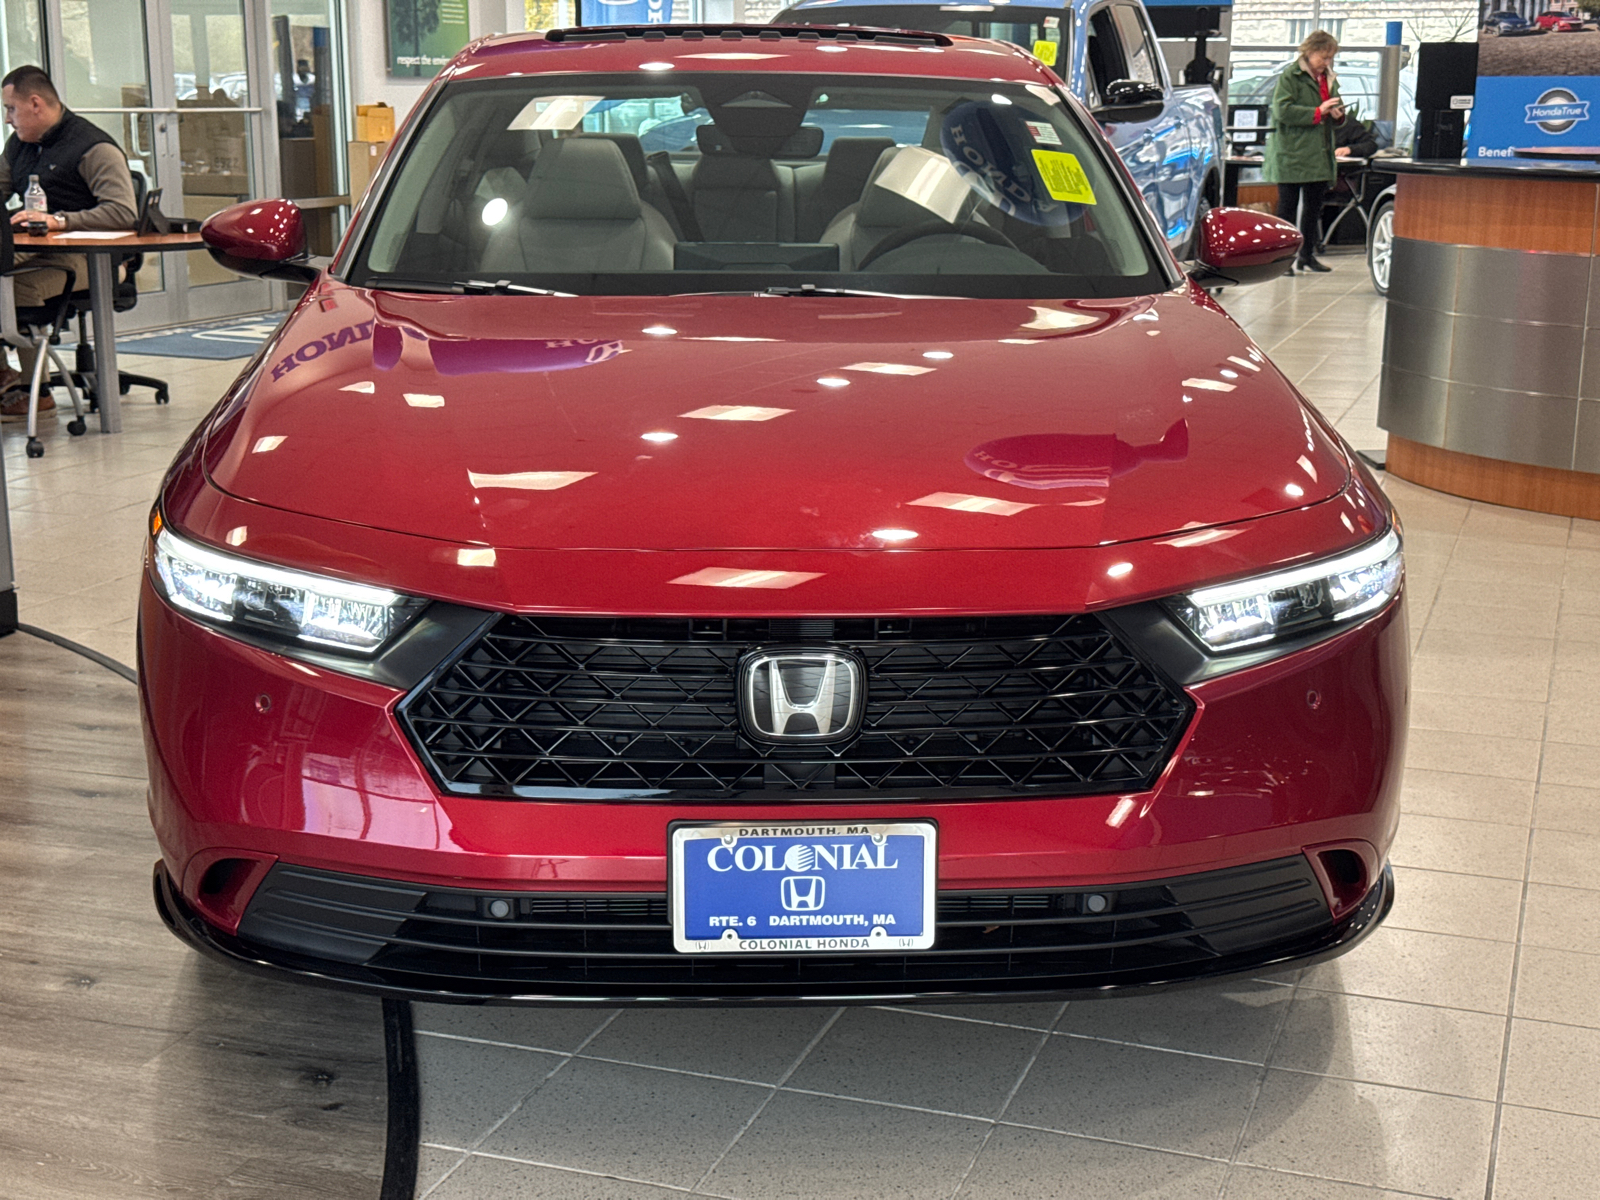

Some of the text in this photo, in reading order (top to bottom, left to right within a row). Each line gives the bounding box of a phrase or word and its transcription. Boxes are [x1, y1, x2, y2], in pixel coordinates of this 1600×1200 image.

[1532, 106, 1581, 117] HondaTrue
[738, 826, 870, 837] DARTMOUTH, MA
[707, 843, 898, 873] COLONIAL
[709, 914, 896, 927] RTE. 6 DARTMOUTH, MA
[738, 938, 870, 951] COLONIAL HONDA
